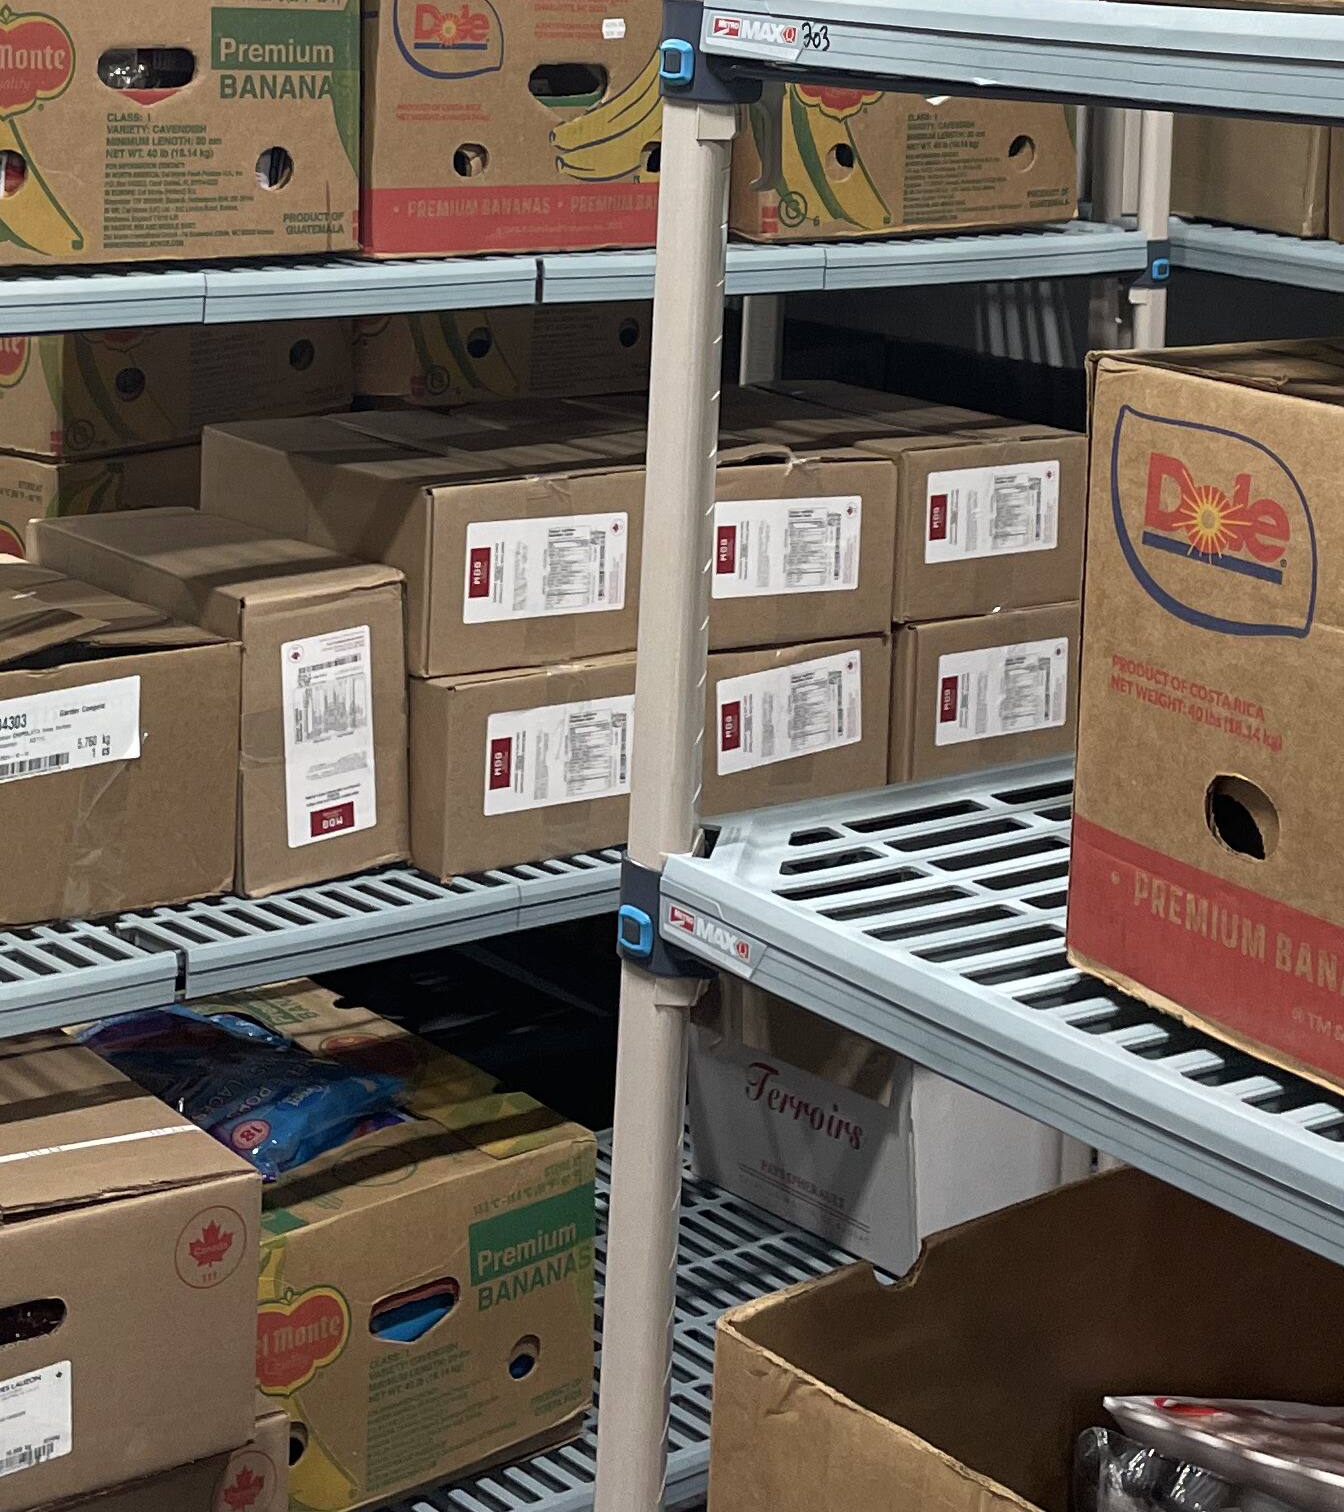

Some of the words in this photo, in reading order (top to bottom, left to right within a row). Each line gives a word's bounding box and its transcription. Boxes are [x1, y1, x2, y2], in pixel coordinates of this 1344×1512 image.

[414, 3, 490, 43] Dole
[801, 21, 830, 51] 203
[219, 37, 335, 64] Premium
[107, 113, 143, 123] CLASS:
[106, 149, 127, 160] NET
[283, 212, 330, 224] PRODUCT
[332, 212, 345, 223] OF
[407, 198, 478, 218] PREMIUM
[481, 196, 552, 217] BANANAS
[570, 193, 636, 214] PREMIUM
[286, 224, 345, 236] GUATEMALA
[1145, 451, 1292, 564] Dole
[1109, 674, 1134, 695] NET
[1135, 681, 1190, 719] WEIGHT:
[1188, 699, 1204, 721] 40
[1204, 704, 1223, 728] lbs
[1111, 654, 1170, 688] PRODUCT
[1171, 673, 1187, 694] OF
[1189, 678, 1234, 712] COSTA
[1235, 692, 1266, 722] RICA
[1133, 869, 1267, 964] PREMIUM
[745, 1061, 864, 1151] Terroirs
[477, 1223, 577, 1277] Premium
[478, 1244, 593, 1312] BANANAS
